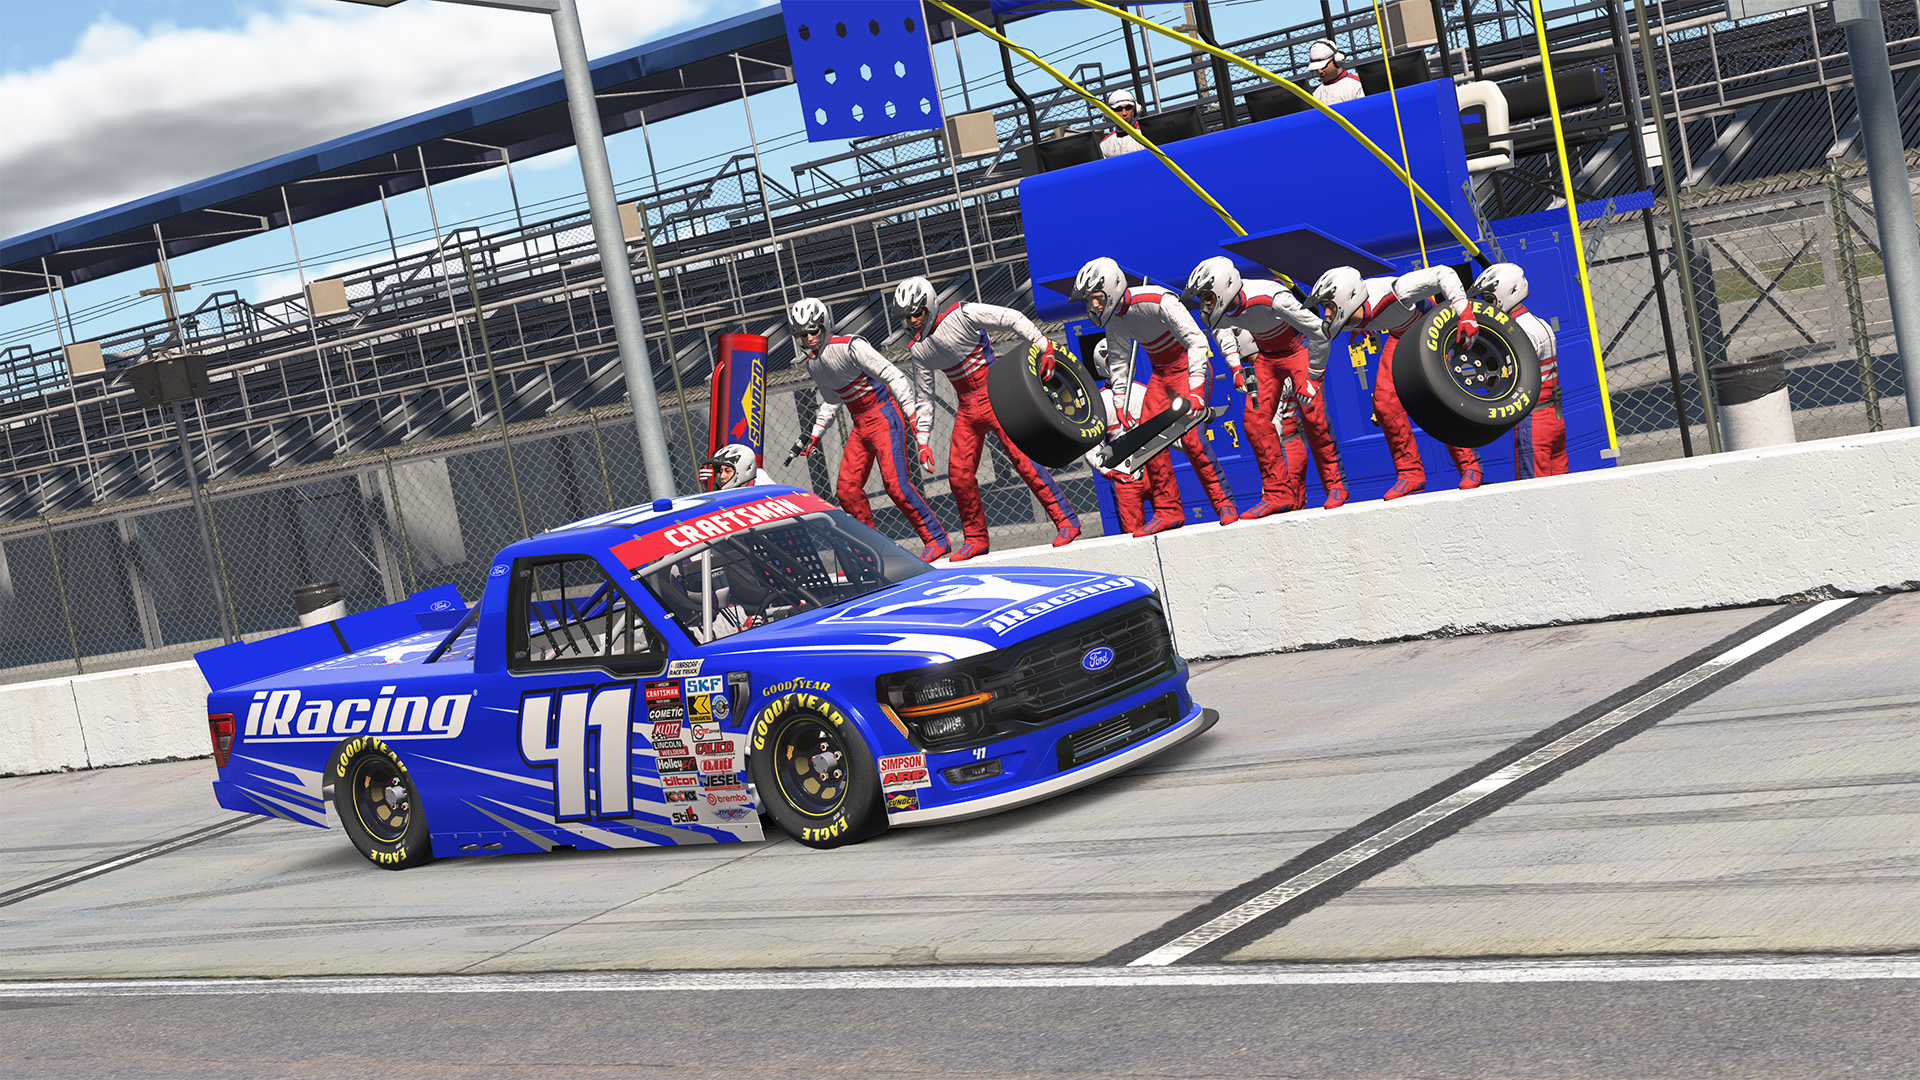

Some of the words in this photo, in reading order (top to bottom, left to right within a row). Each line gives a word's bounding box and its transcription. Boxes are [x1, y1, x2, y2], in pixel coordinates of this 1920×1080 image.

[1427, 300, 1510, 351] GOODEAR
[749, 359, 764, 446] SUNOCO
[1488, 392, 1531, 418] EAGLE
[1080, 420, 1105, 438] EAGLE
[663, 499, 805, 548] CRAFTSMAN
[982, 577, 1136, 634] iRacing
[1090, 650, 1109, 667] Ford
[646, 689, 678, 698] CRAFTSMAN
[687, 678, 721, 693] SKF
[762, 676, 831, 697] GOODYEAR
[243, 685, 473, 739] iRacing
[649, 706, 683, 718] COMETIC
[655, 723, 680, 735] KLOTZ
[753, 692, 844, 751] GOODYEAR
[518, 682, 635, 822] 41
[653, 740, 682, 749] LINCOLN
[696, 741, 734, 754] CALICO
[336, 735, 408, 778] GOODYEAR
[972, 747, 986, 760] 41
[657, 757, 682, 771] Holley
[881, 755, 922, 771] SIMPSON
[663, 776, 697, 786] tilton
[704, 774, 741, 787] JESEL
[883, 770, 928, 785] ARP
[665, 791, 697, 802] KOOKS
[716, 793, 747, 803] brembo
[887, 797, 918, 807] SUNOCO
[672, 805, 699, 823] Stilo
[801, 816, 849, 841] EAGLE
[370, 847, 408, 864] EAGLE
